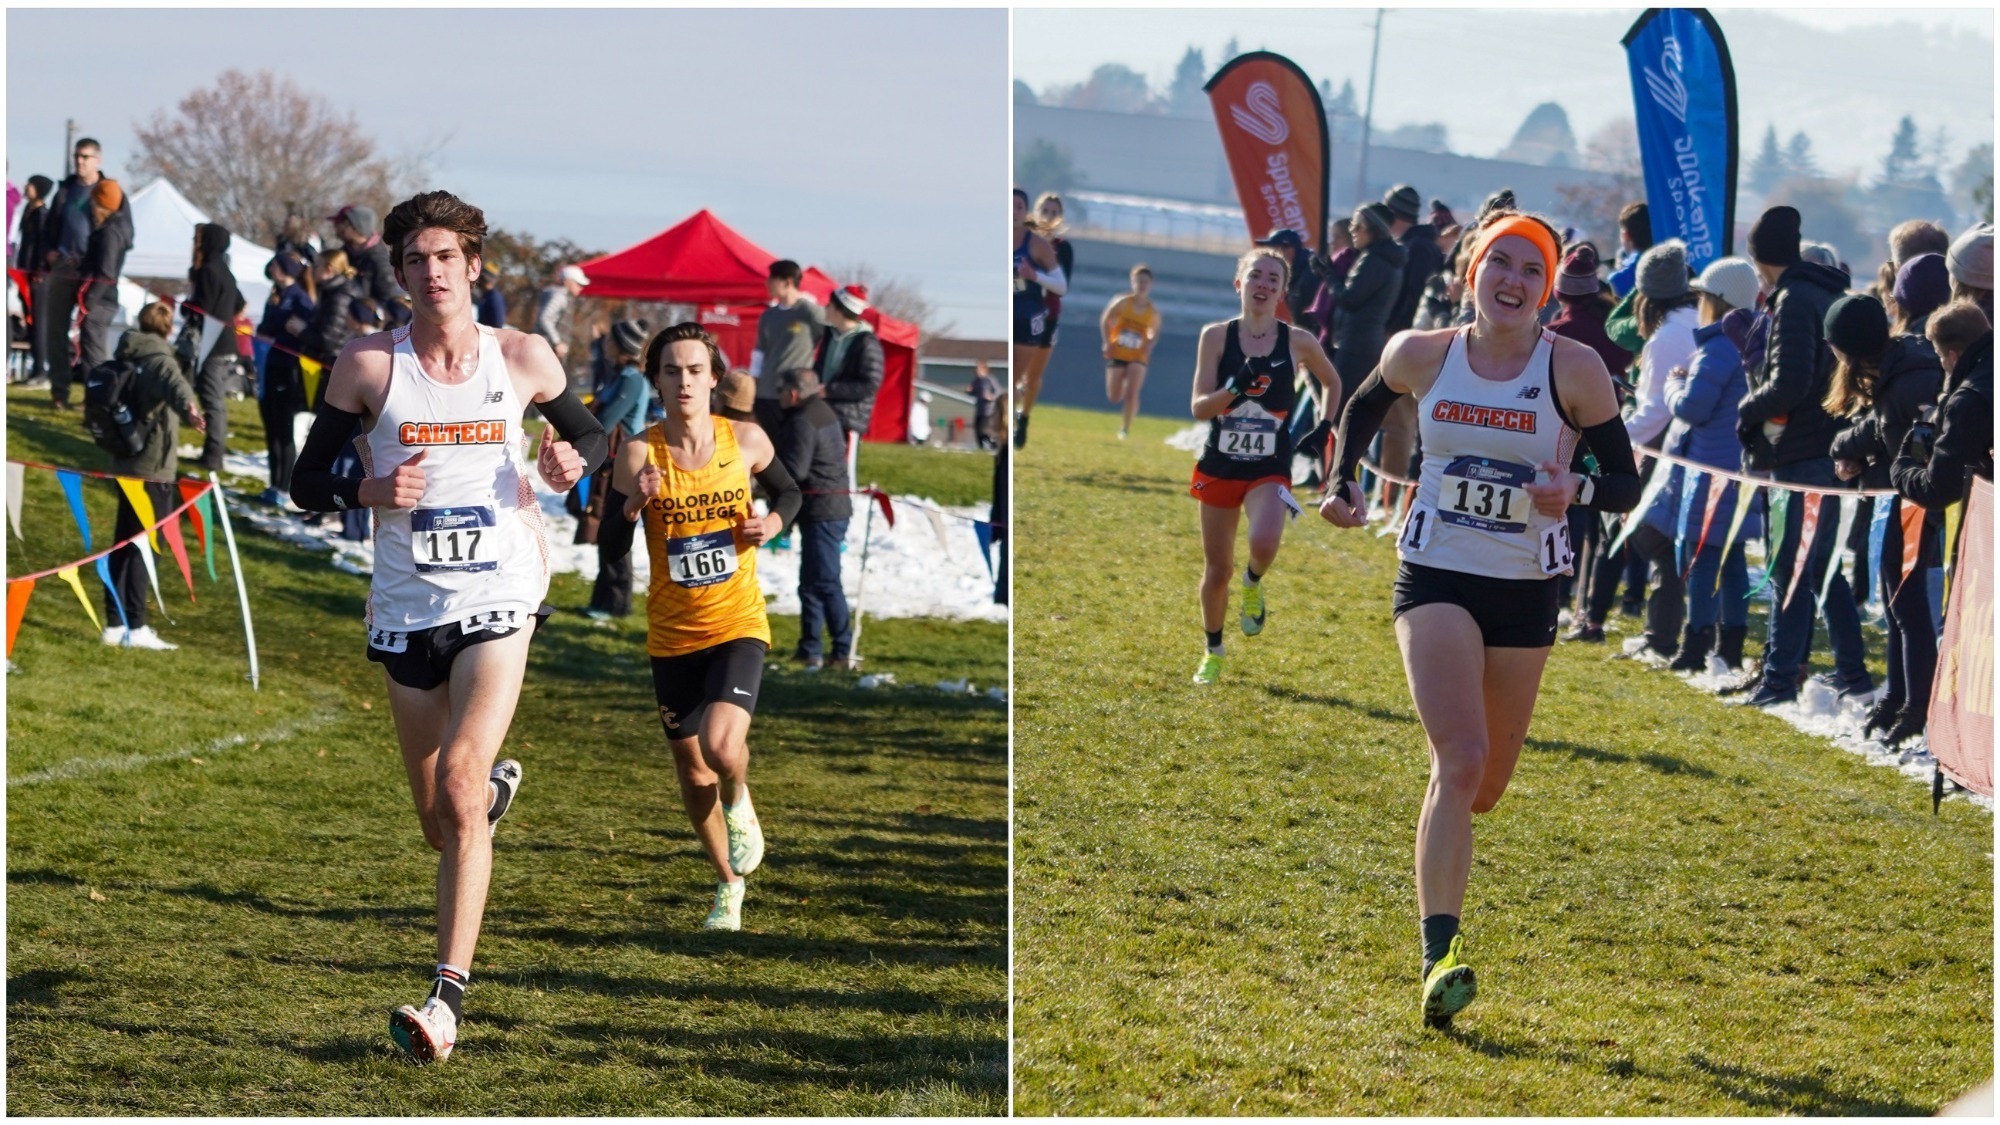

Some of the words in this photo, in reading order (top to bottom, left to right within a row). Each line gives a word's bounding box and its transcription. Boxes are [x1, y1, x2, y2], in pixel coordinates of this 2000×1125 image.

[1260, 184, 1284, 229] SPOR
[400, 420, 506, 445] CALTECH
[1432, 400, 1536, 434] CALTECH
[1227, 432, 1265, 454] 244
[652, 488, 744, 511] COLORADO
[662, 504, 737, 525] COLLEGE
[1454, 480, 1512, 520] 131
[1401, 510, 1426, 549] 1
[427, 530, 481, 562] 117
[680, 549, 727, 579] 166
